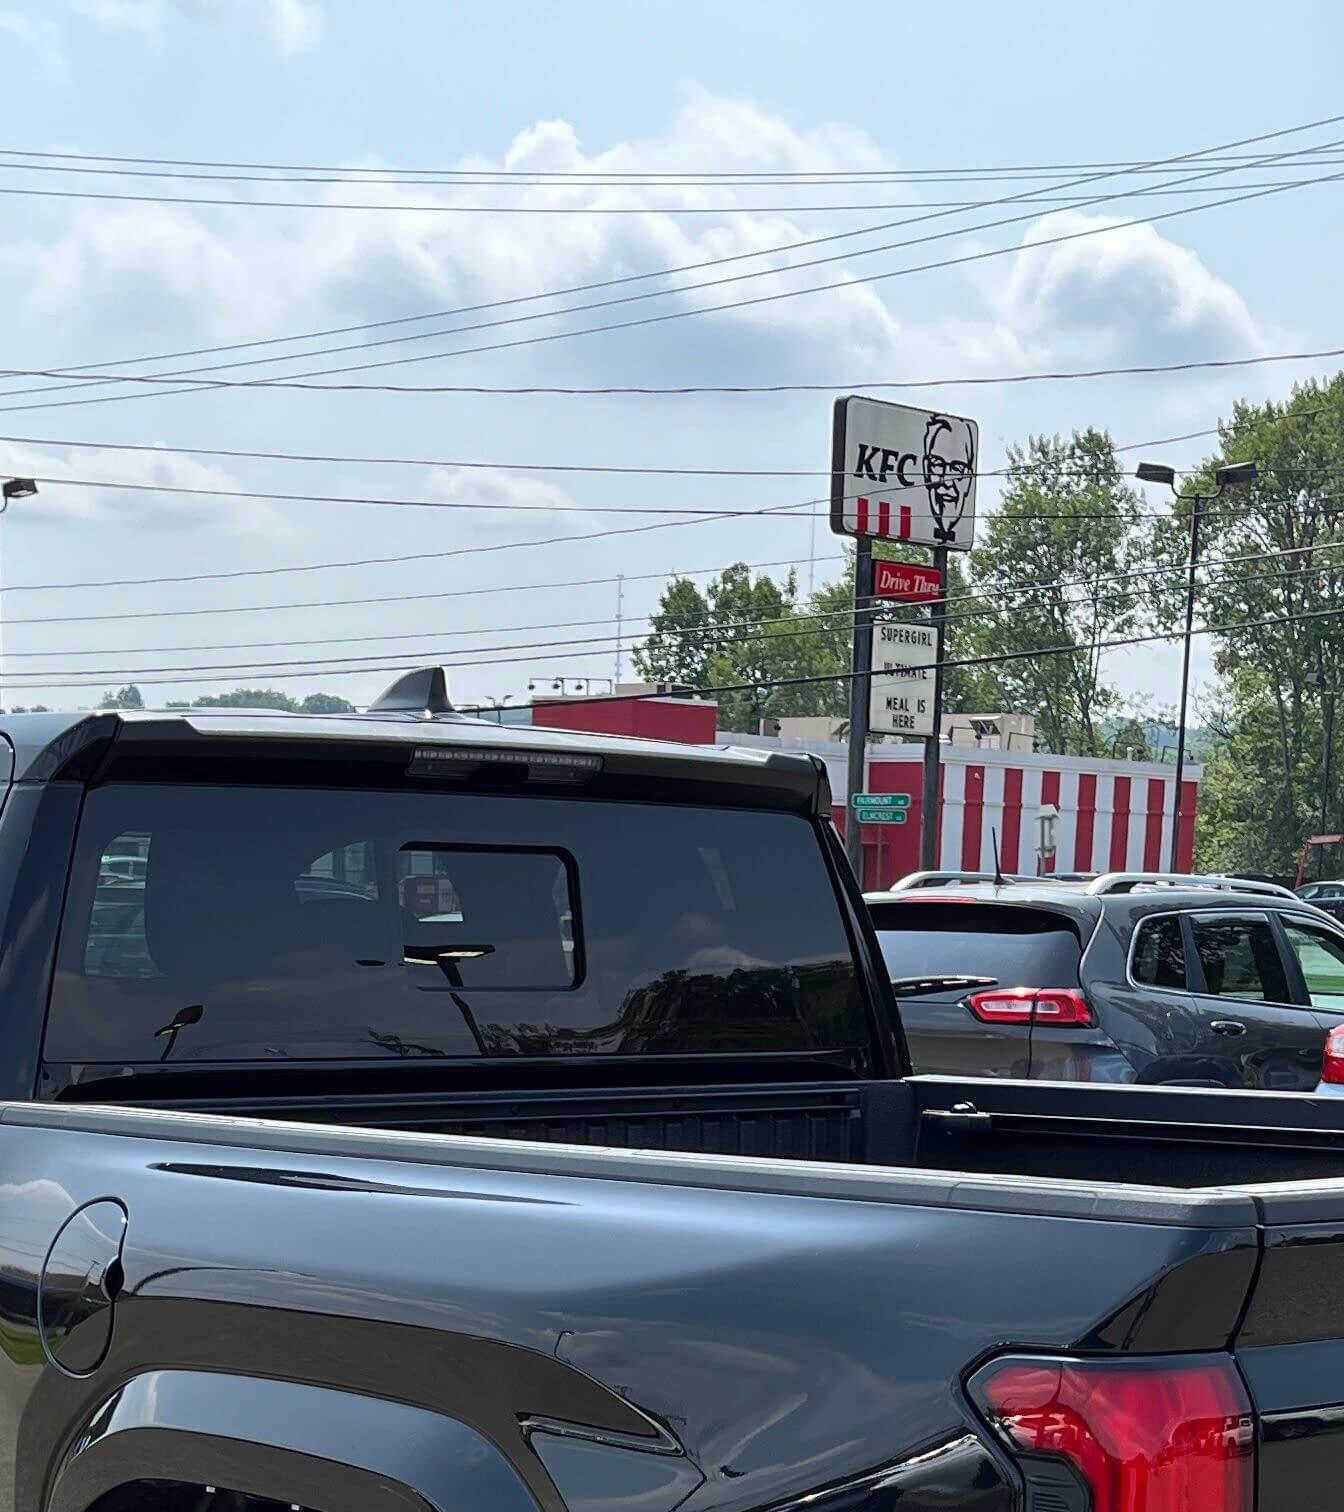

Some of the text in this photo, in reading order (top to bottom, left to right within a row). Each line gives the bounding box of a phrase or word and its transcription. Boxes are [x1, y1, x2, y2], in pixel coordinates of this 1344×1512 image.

[853, 443, 918, 487] KFC
[879, 570, 940, 596] Drive Thru
[880, 626, 933, 647] SUPERGIRL
[885, 696, 927, 714] MEAL IS
[891, 713, 915, 729] HERE
